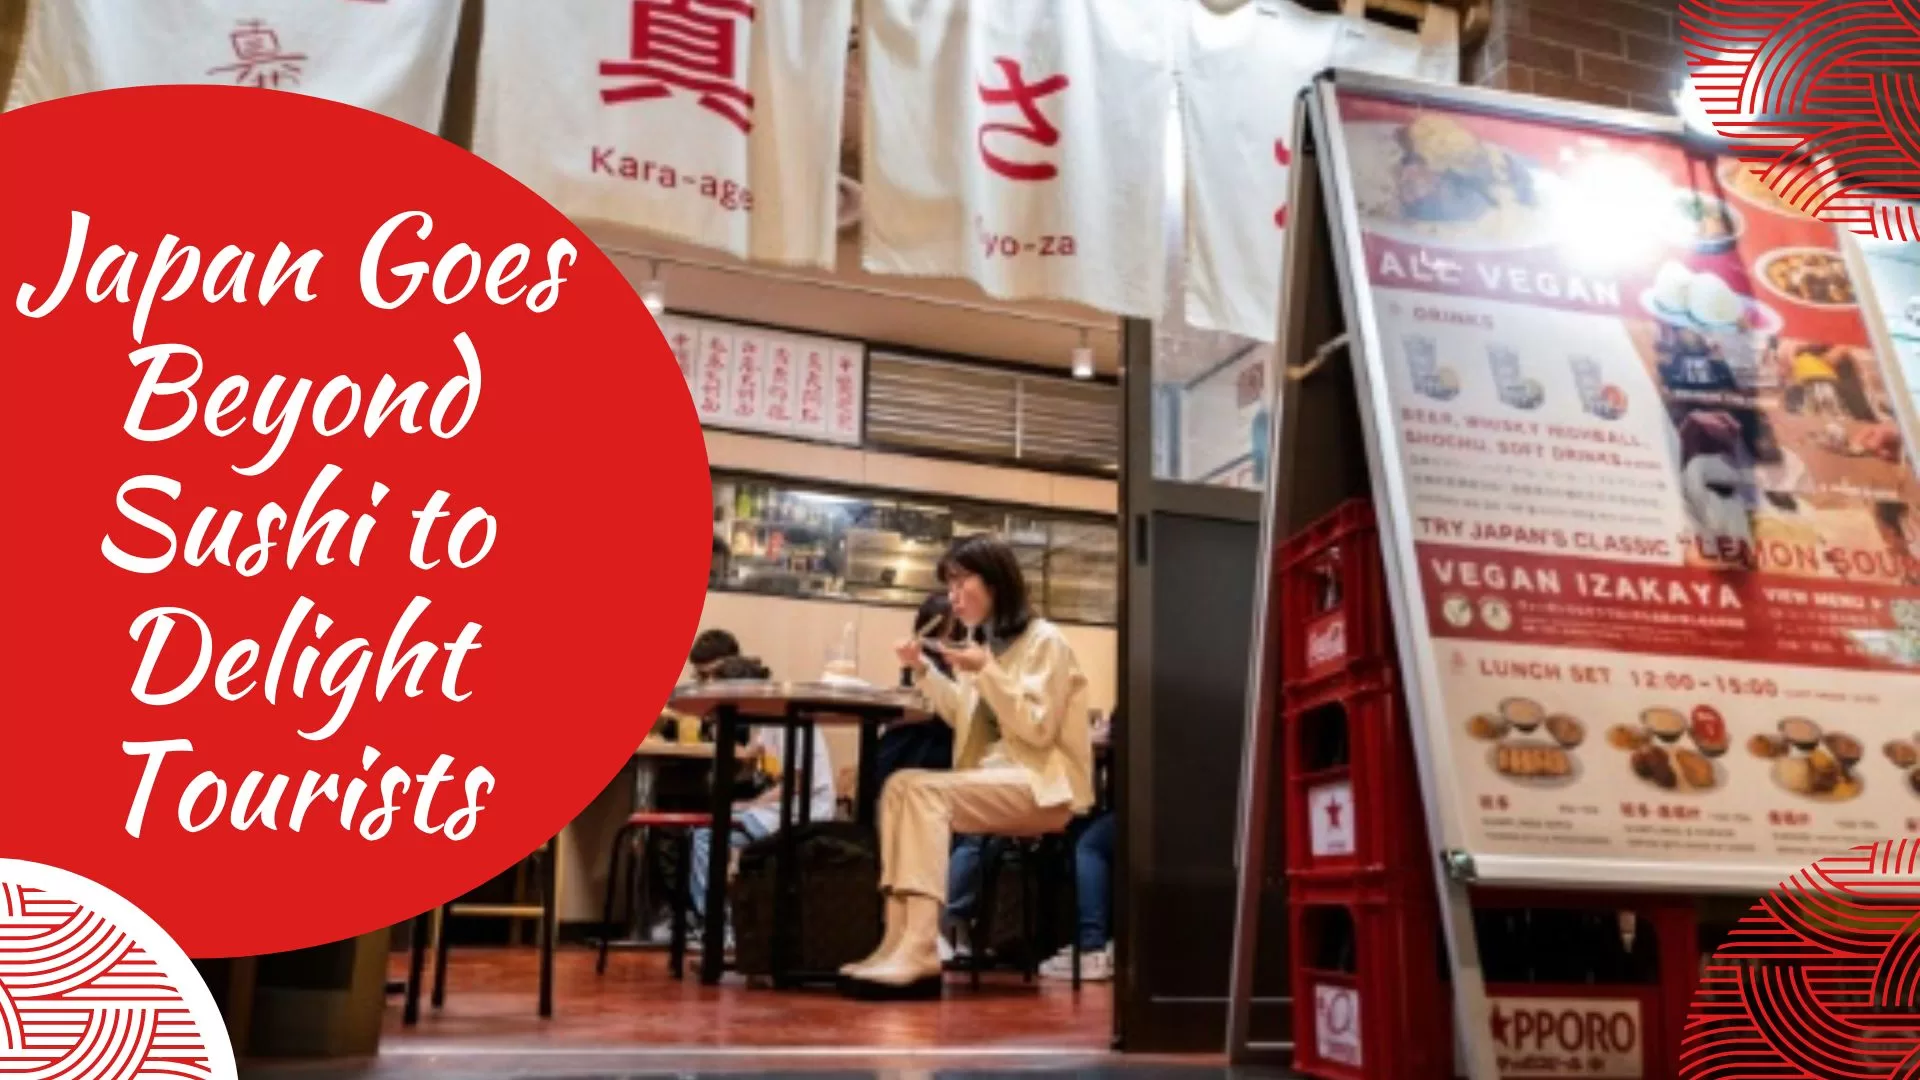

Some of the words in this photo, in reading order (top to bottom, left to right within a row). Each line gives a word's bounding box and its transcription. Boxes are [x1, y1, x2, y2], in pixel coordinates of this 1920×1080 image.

[978, 57, 1070, 181] さ
[976, 215, 1077, 258] yo-za
[1478, 264, 1620, 306] VEGAN
[1413, 307, 1494, 328] DRINKS
[1419, 517, 1465, 537] TRY
[1574, 531, 1671, 556] CLASSIC
[1431, 557, 1563, 594] VEGAN
[1575, 570, 1742, 610] IZAKAYA
[1479, 659, 1561, 682] LUNCH
[1571, 667, 1612, 684] SET
